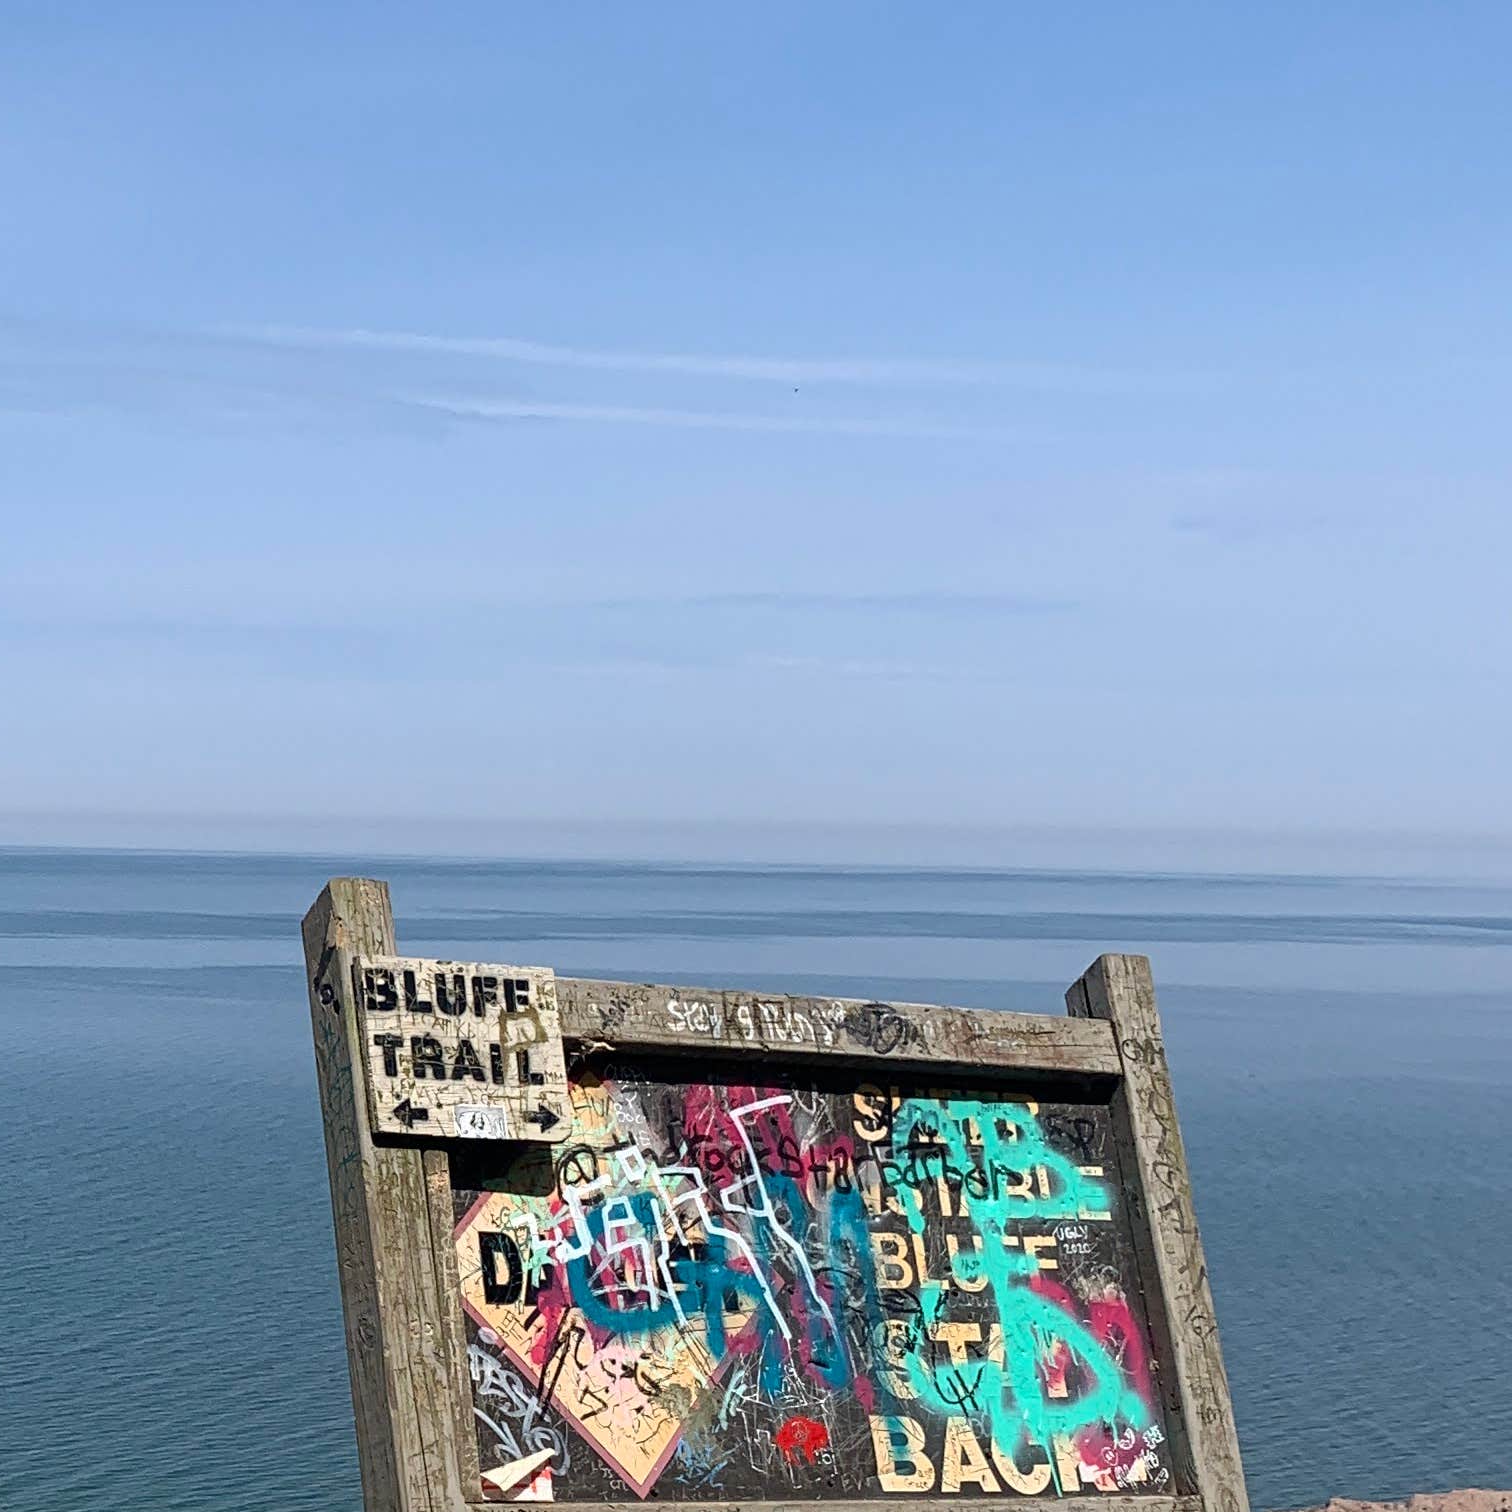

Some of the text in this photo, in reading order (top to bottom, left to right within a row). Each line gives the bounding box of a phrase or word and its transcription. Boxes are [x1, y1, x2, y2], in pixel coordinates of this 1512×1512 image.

[365, 967, 531, 1017] BLUFF
[374, 1032, 546, 1085] TRAIL
[1052, 1225, 1088, 1241] UGLY
[1063, 1242, 1092, 1255] 2020
